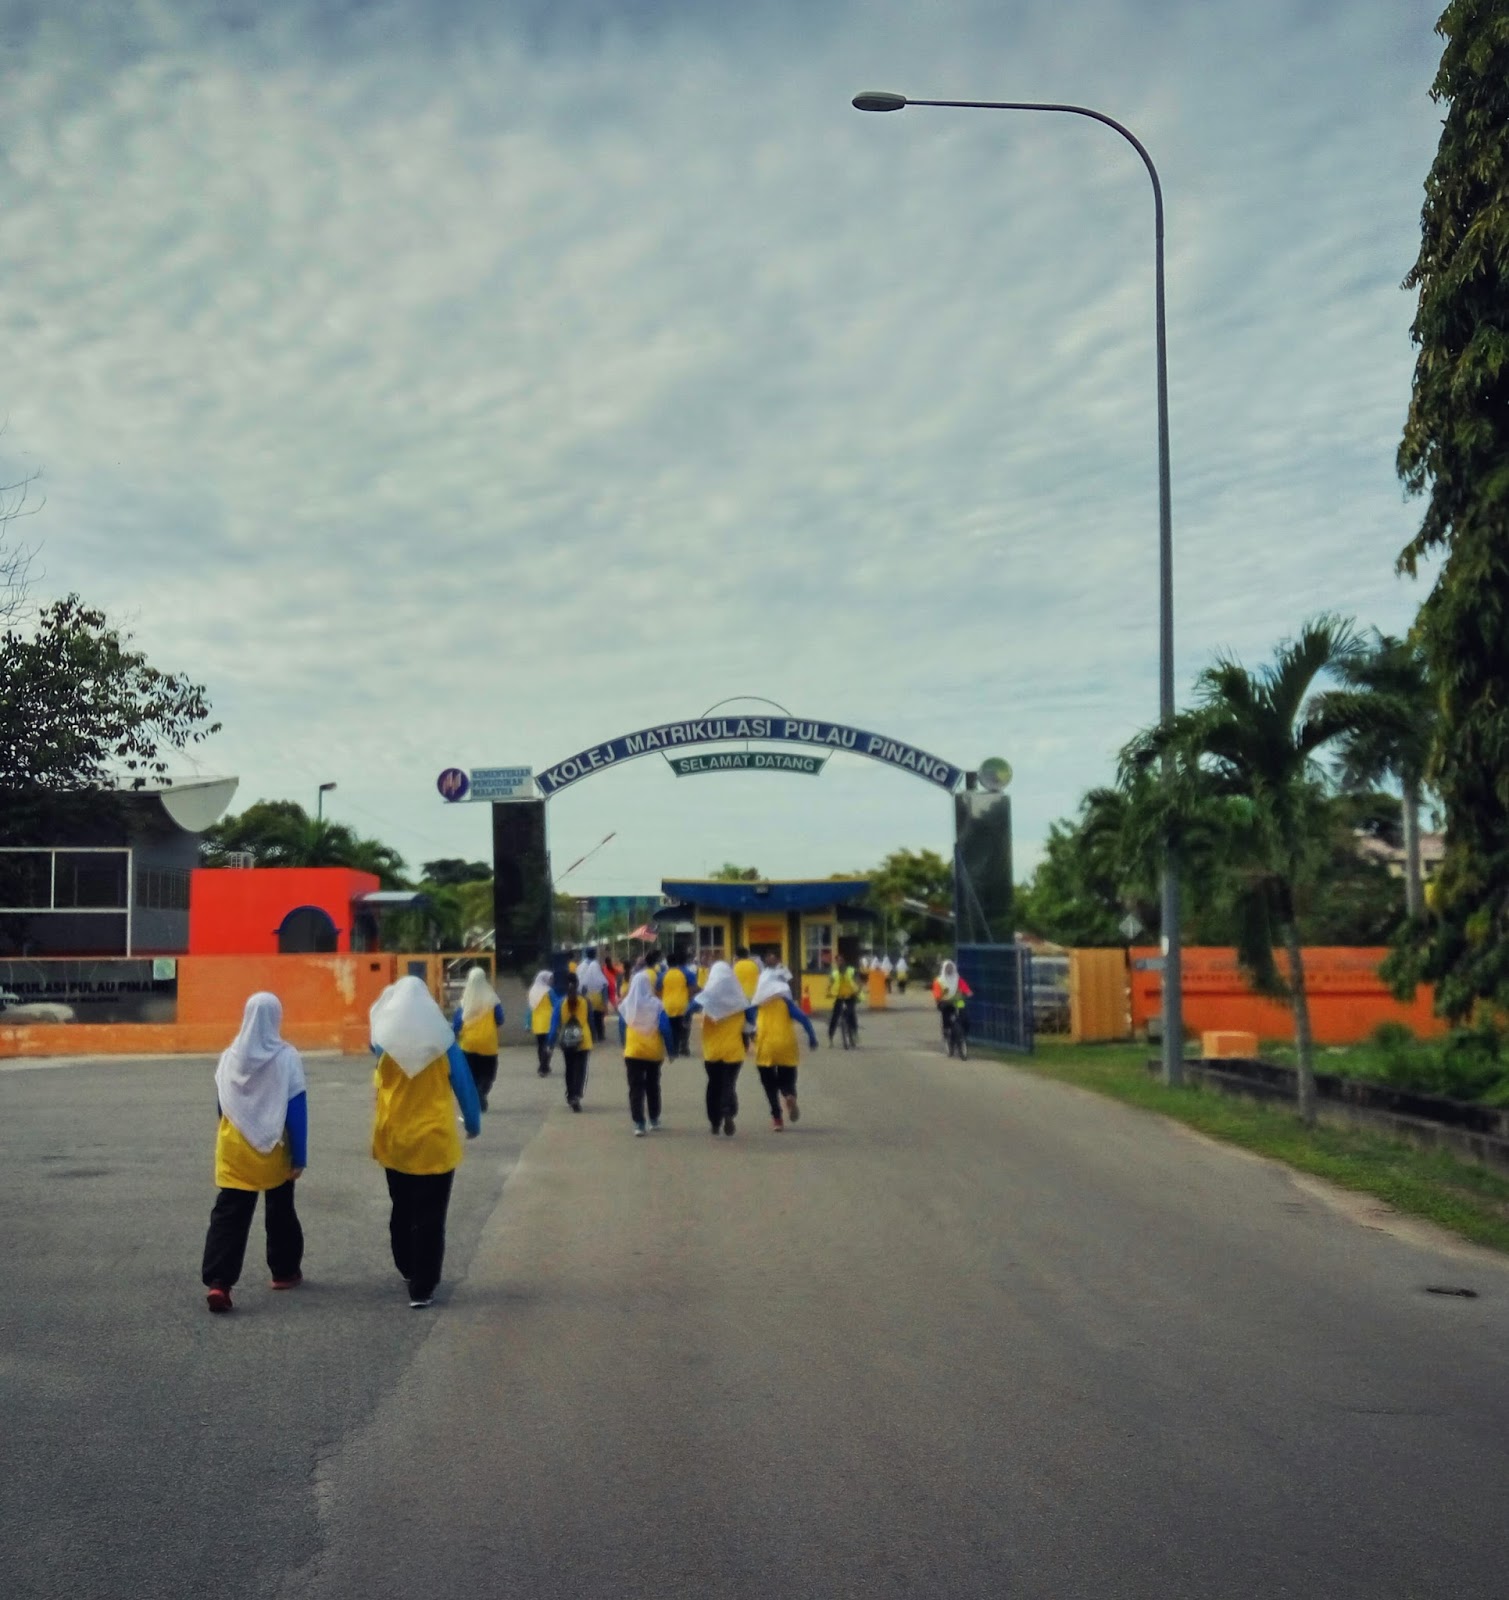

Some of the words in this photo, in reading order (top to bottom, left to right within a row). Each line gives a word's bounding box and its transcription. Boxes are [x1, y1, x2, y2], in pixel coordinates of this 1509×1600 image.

[548, 746, 616, 787] KOLEJ
[626, 720, 771, 753] MATRIKULASI
[784, 720, 857, 747] PULAU
[867, 737, 949, 783] PINANG
[680, 755, 749, 772] SELAMAT
[755, 755, 815, 771] DATANG
